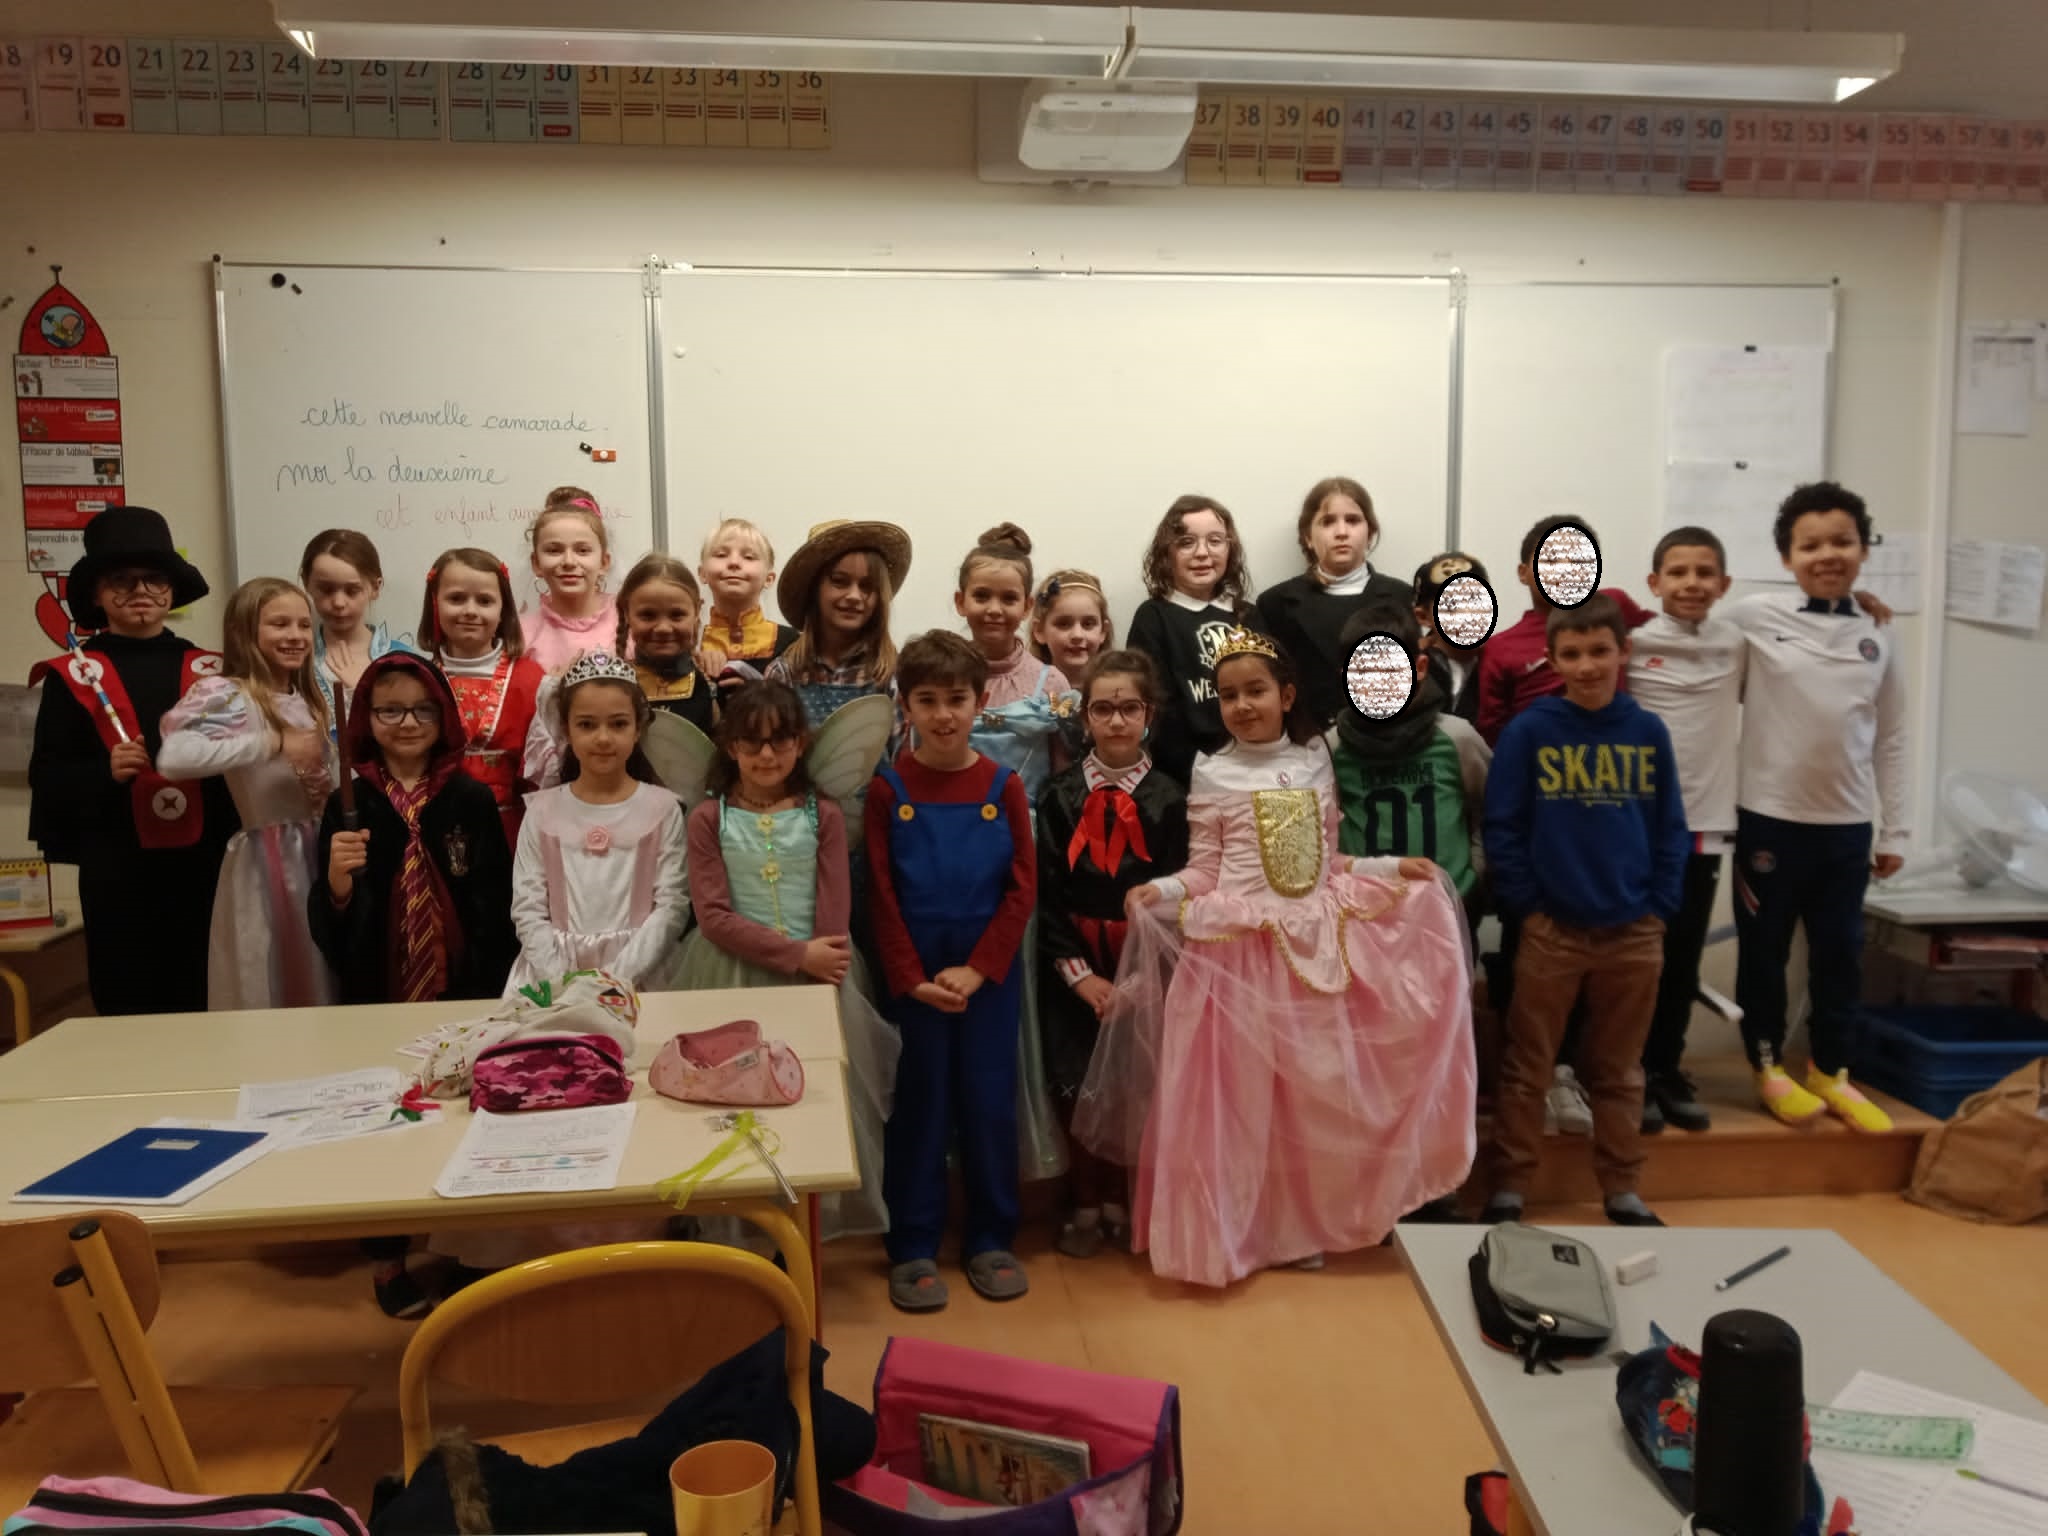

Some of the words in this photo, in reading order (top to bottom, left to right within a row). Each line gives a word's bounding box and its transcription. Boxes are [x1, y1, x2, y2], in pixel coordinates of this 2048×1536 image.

[46, 44, 73, 66] 19
[90, 45, 121, 67] 20
[137, 48, 164, 69] 21
[182, 50, 211, 71] 22
[228, 51, 255, 72] 23
[273, 52, 301, 74] 24
[317, 59, 343, 75] 25
[360, 60, 387, 77] 26
[405, 61, 430, 77] 27
[458, 63, 484, 79] 28
[501, 63, 527, 80] 29
[543, 64, 571, 81] 30
[586, 65, 610, 83] 31
[628, 66, 654, 84] 32
[671, 68, 697, 86] 33
[712, 69, 739, 87] 34
[754, 71, 781, 88] 35
[797, 72, 823, 89] 36
[1197, 103, 1221, 124] 37
[1235, 104, 1260, 126] 38
[1274, 105, 1299, 127] 39
[1311, 106, 1339, 128] 40
[1352, 109, 1375, 129] 41
[1391, 110, 1416, 130] 42
[1429, 111, 1454, 131] 43
[1468, 112, 1493, 131] 44
[1506, 112, 1531, 133] 45
[1551, 114, 1574, 134] 46
[1586, 114, 1613, 134] 47
[1624, 116, 1647, 136] 48
[1660, 117, 1684, 137] 49
[1696, 118, 1722, 138] 50
[1735, 120, 1756, 140] 51
[1768, 120, 1793, 142] 52
[1807, 122, 1830, 143] 53
[1844, 122, 1868, 143] 54
[300, 398, 365, 427] cette
[380, 401, 472, 427] nouvelle
[344, 445, 376, 482] la
[1187, 678, 1219, 704] WE
[1537, 743, 1657, 794] SKATE
